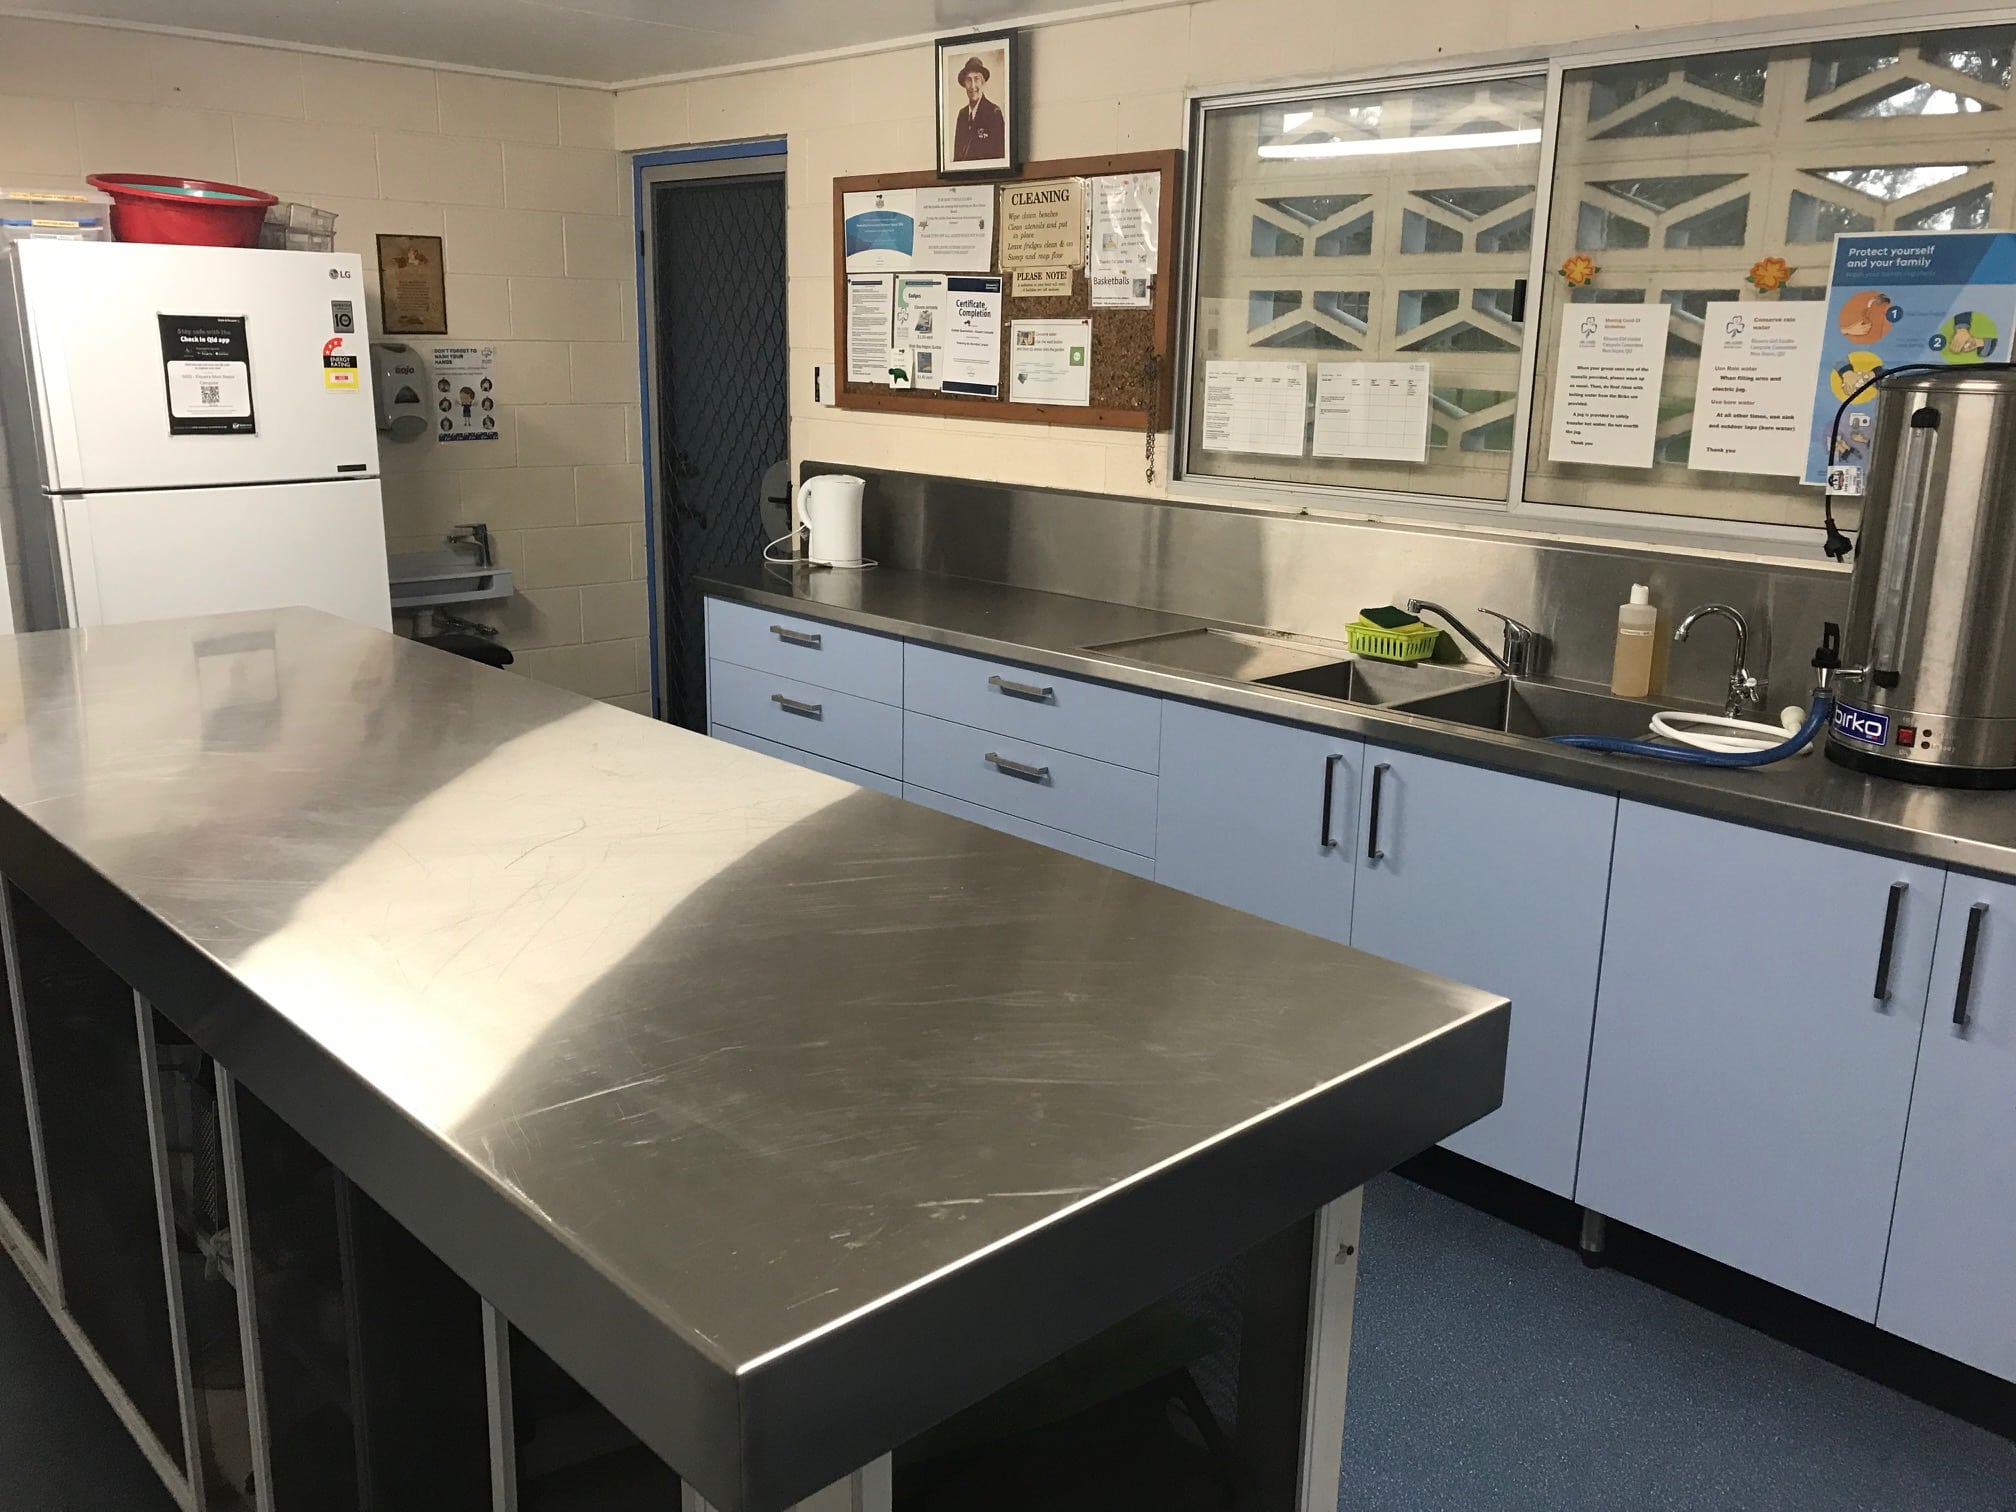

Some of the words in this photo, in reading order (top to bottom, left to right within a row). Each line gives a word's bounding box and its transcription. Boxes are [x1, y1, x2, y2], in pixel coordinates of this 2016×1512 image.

[1011, 189, 1070, 206] CLEANING
[1038, 210, 1058, 218] benches
[1007, 223, 1023, 231] Clean
[1046, 221, 1057, 229] and
[1058, 221, 1068, 230] put
[1020, 231, 1034, 241] place
[1043, 240, 1058, 248] clean
[1024, 252, 1036, 260] and
[1848, 247, 1889, 257] Protect
[1890, 245, 1936, 257] yourself
[1847, 258, 1868, 268] and
[1870, 259, 1894, 269] your
[1896, 257, 1932, 268] family
[340, 271, 351, 279] LG
[1017, 272, 1043, 281] PLEASE
[1045, 271, 1068, 280] NOTE!
[1093, 276, 1130, 285] Basketballs
[955, 299, 986, 309] Certificate
[958, 308, 991, 318] Completion
[1891, 309, 1898, 319] 1
[334, 313, 352, 328] 10
[180, 335, 199, 343] Check
[206, 336, 218, 344] Qld
[1933, 337, 1942, 348] 2
[1834, 704, 1882, 737] birko
